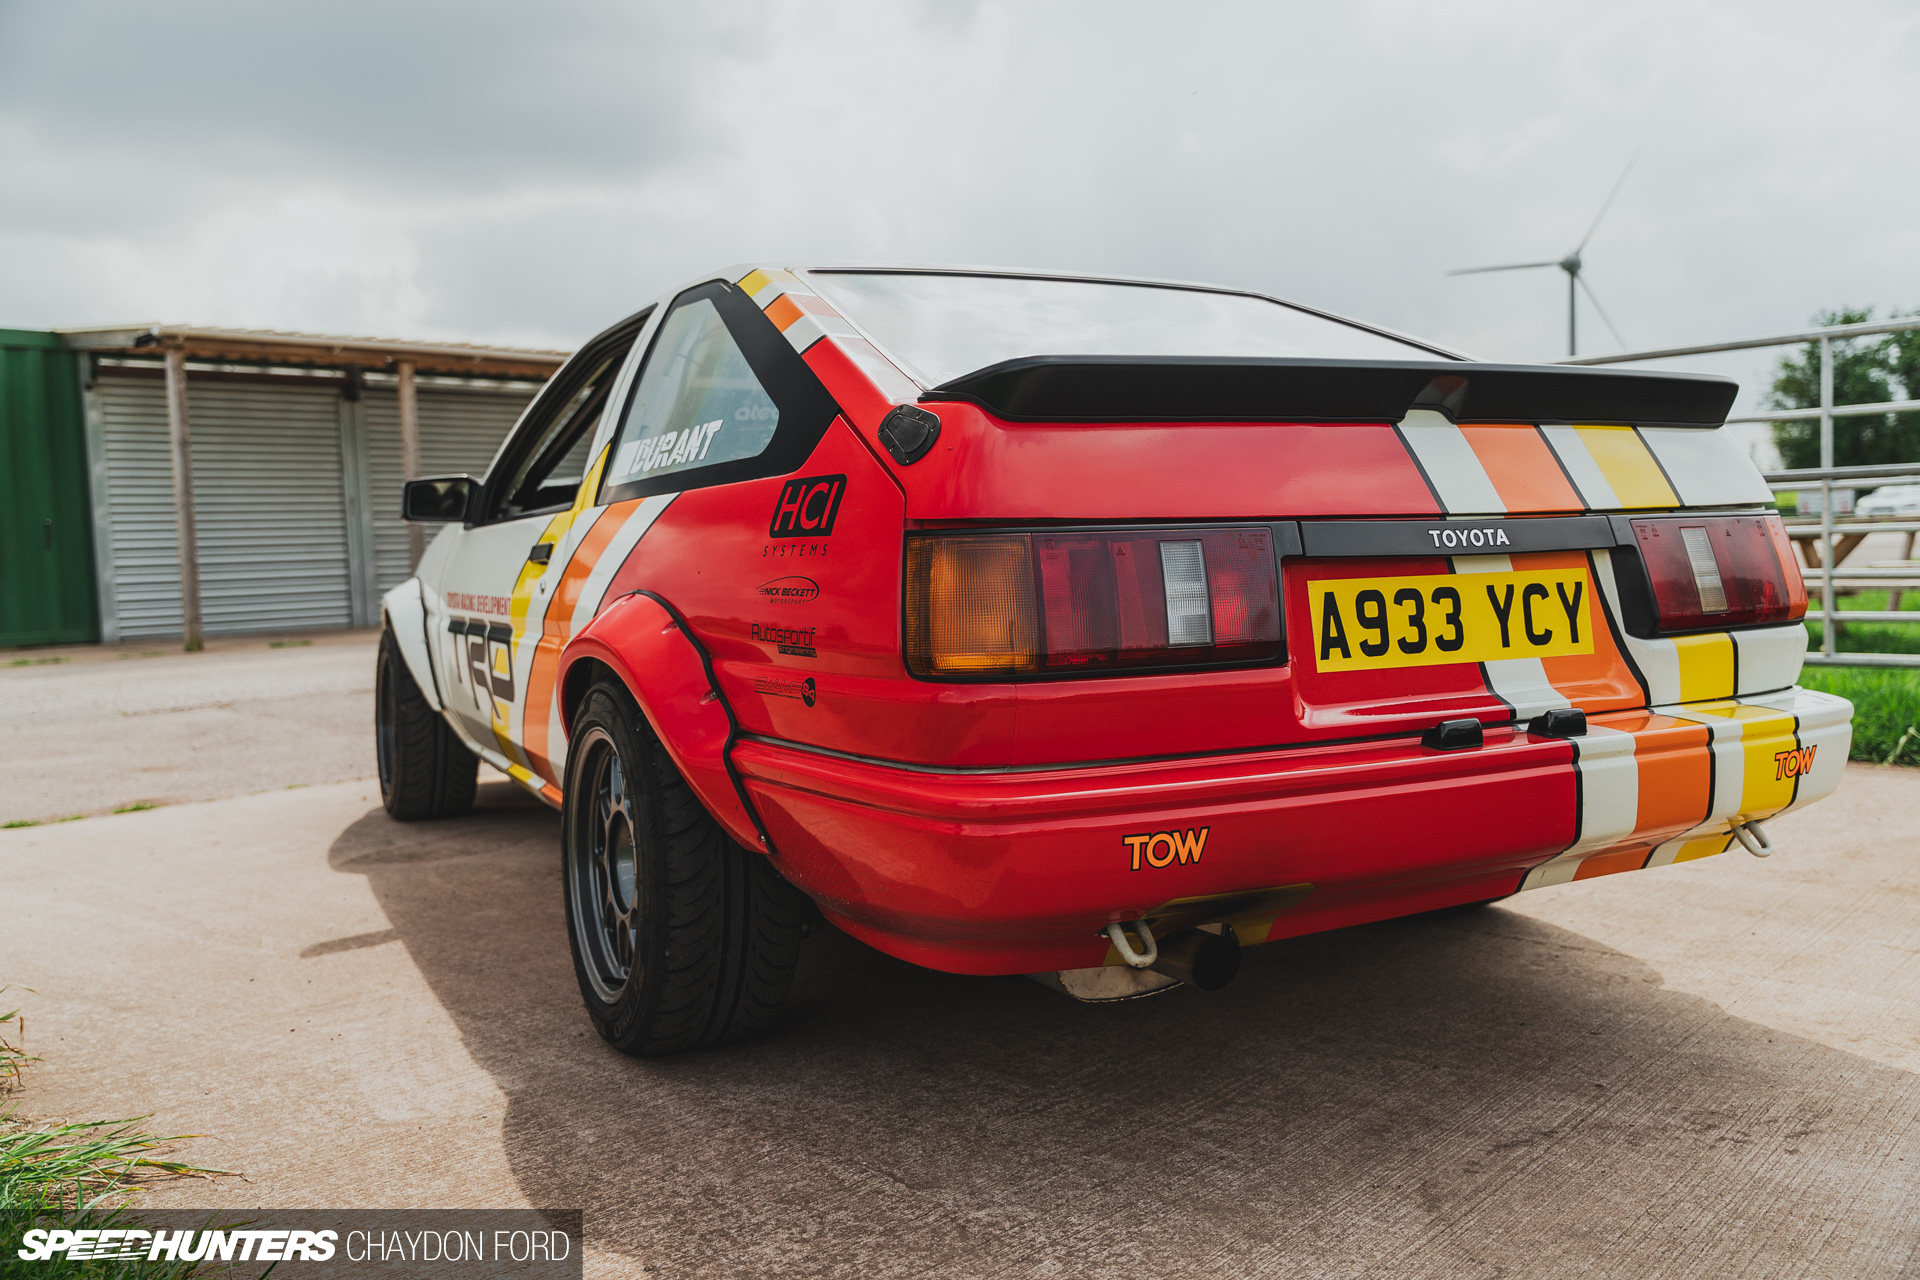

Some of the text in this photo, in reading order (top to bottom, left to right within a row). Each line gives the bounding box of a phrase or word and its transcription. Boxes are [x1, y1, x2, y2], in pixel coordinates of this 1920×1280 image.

[629, 419, 724, 475] DURANT
[773, 481, 840, 532] HCI
[762, 543, 829, 558] SYSTEMS
[1428, 527, 1511, 549] TOYOTA
[476, 594, 511, 616] DEVELOPMENT
[764, 587, 816, 598] NICK BECKETT
[769, 598, 806, 606] MOTORSPORT
[1319, 580, 1583, 661] A933 YCY
[751, 622, 816, 647] Autosportif
[778, 645, 816, 657] Engineering
[447, 616, 515, 720] TRD
[1774, 744, 1818, 781] TOW
[1121, 825, 1211, 872] TOW
